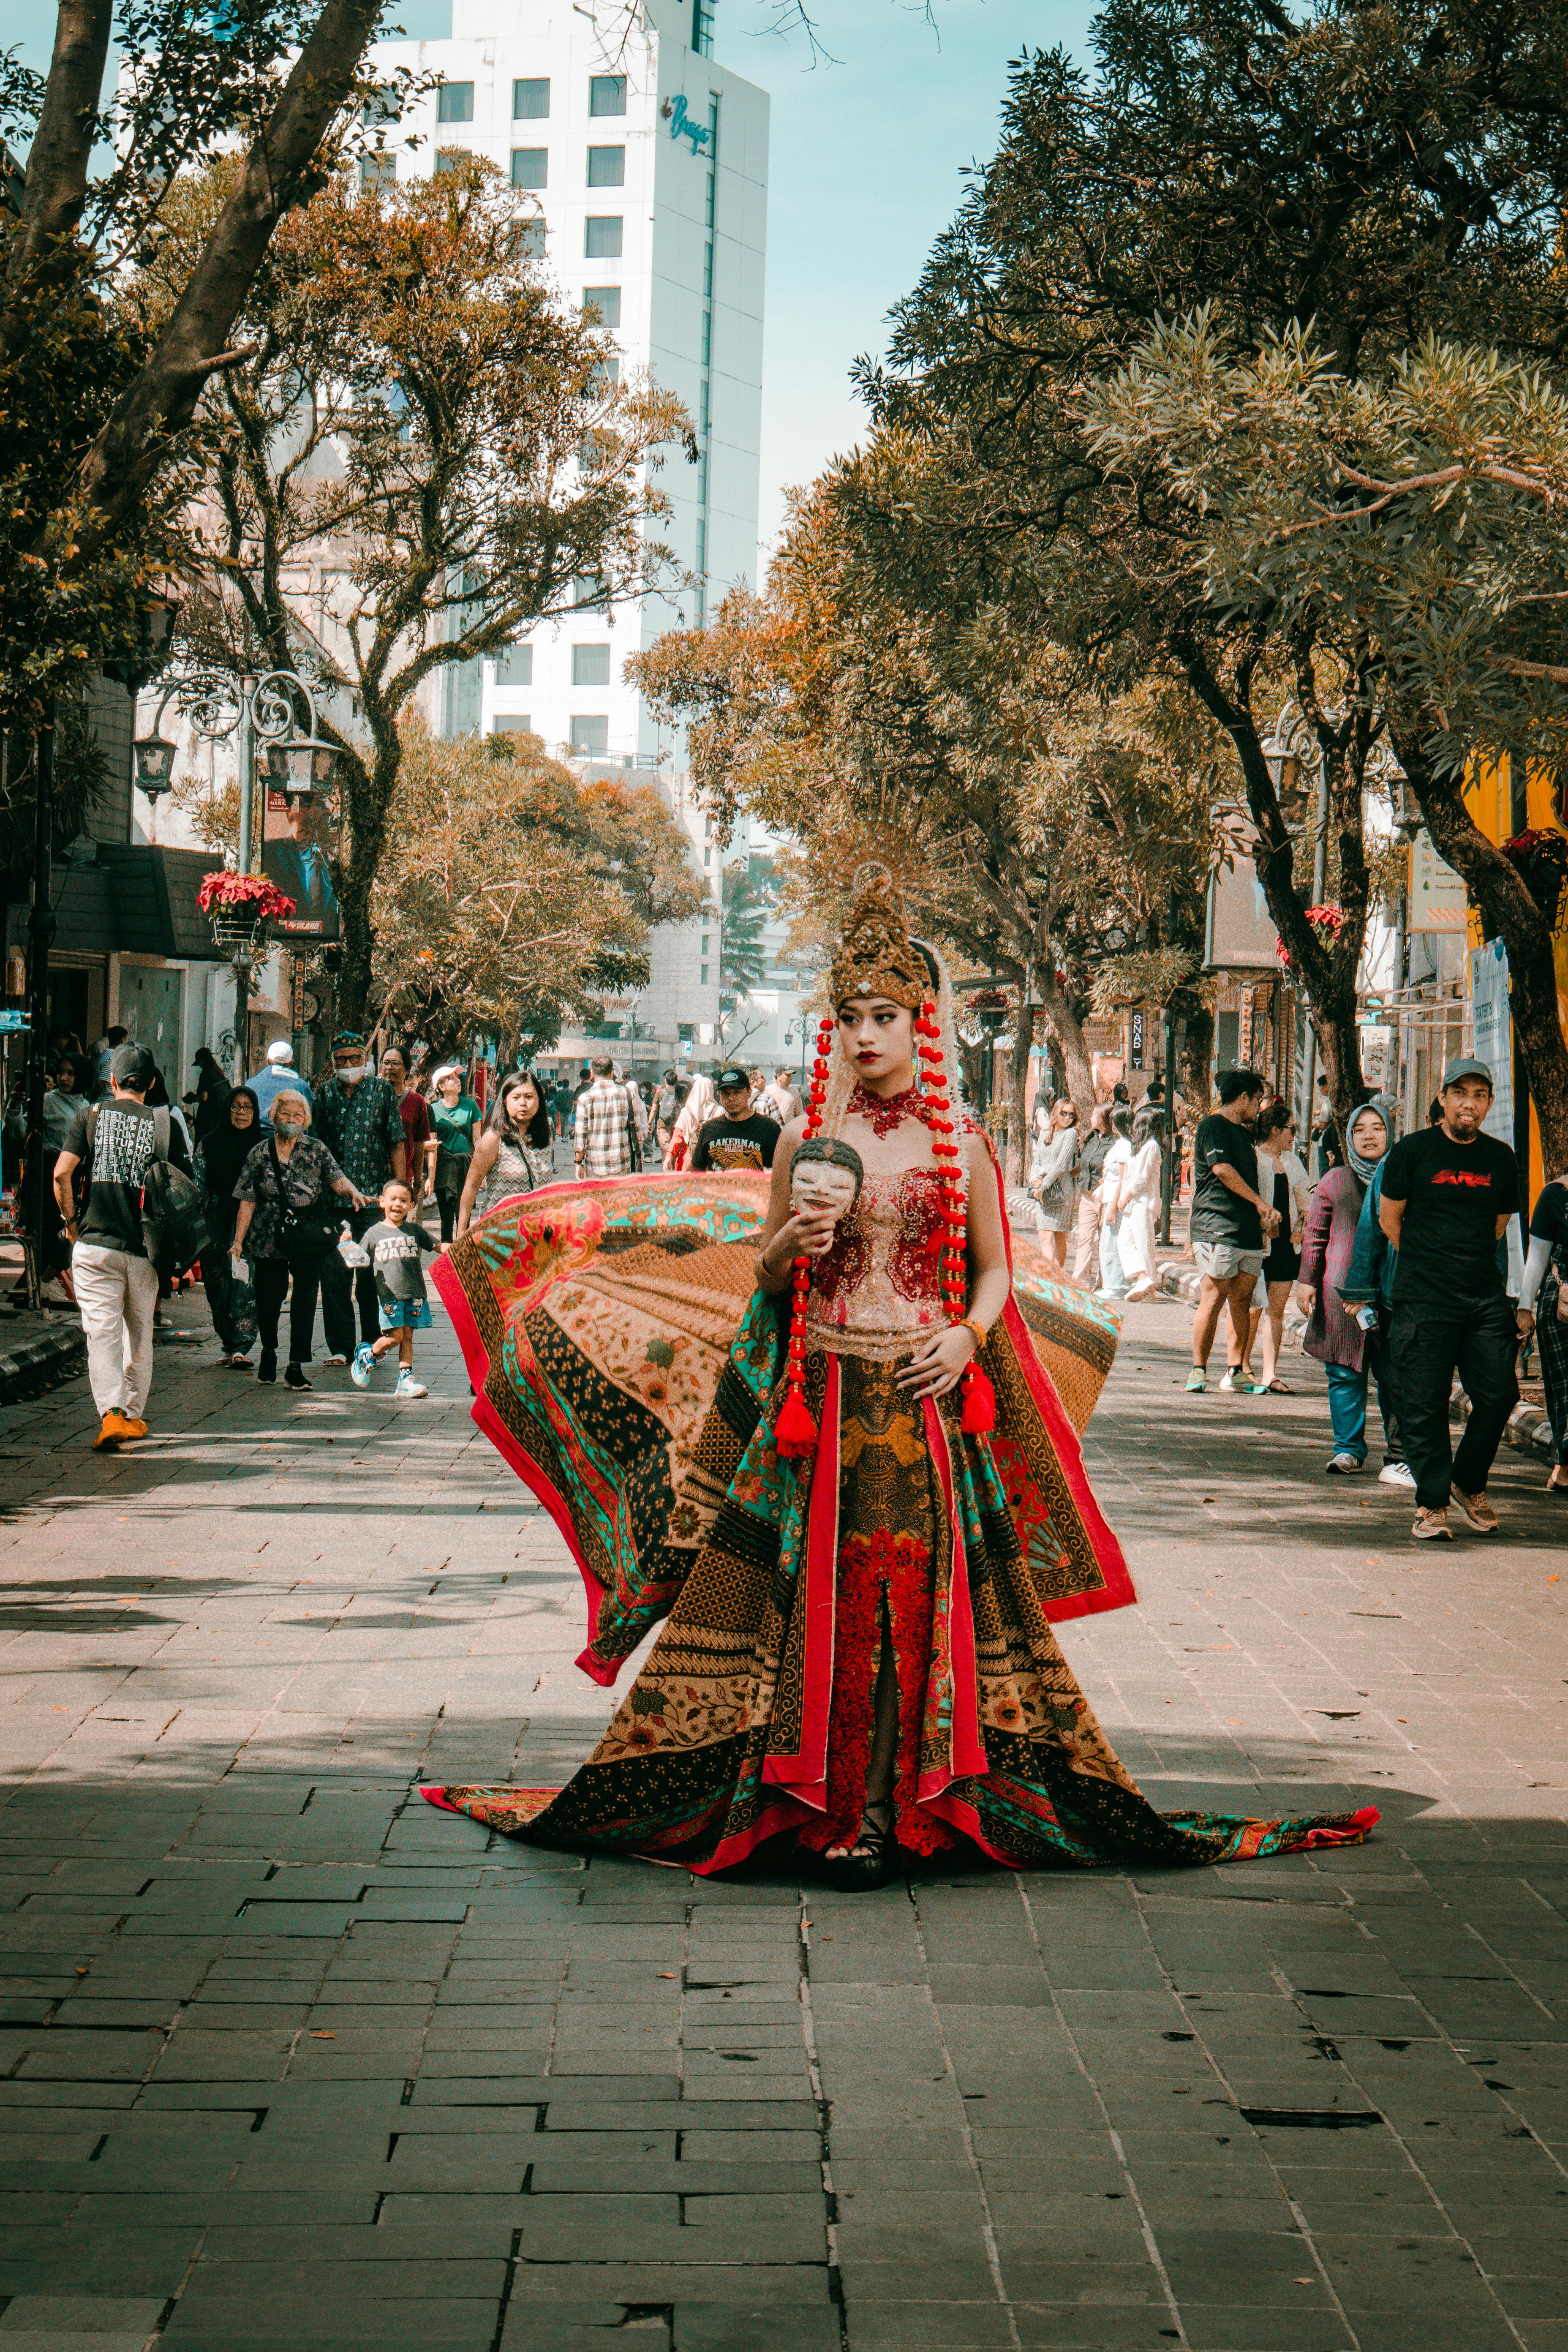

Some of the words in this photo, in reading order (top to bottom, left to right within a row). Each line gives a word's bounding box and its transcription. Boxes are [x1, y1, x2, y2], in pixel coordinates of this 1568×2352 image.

[684, 1042, 691, 1051] P
[98, 1109, 138, 1125] MEETUP
[97, 1118, 136, 1131] MEETUP
[95, 1126, 135, 1139] MEETUP
[94, 1136, 134, 1149] MEETUP
[709, 1138, 761, 1151] RAKERNAS
[95, 1145, 133, 1158] MEETUP
[94, 1154, 131, 1166] MEETUP
[92, 1162, 129, 1176] MEETUP
[92, 1172, 128, 1183] MEETUP
[378, 1236, 418, 1250] STAR
[375, 1246, 418, 1262] WARS
